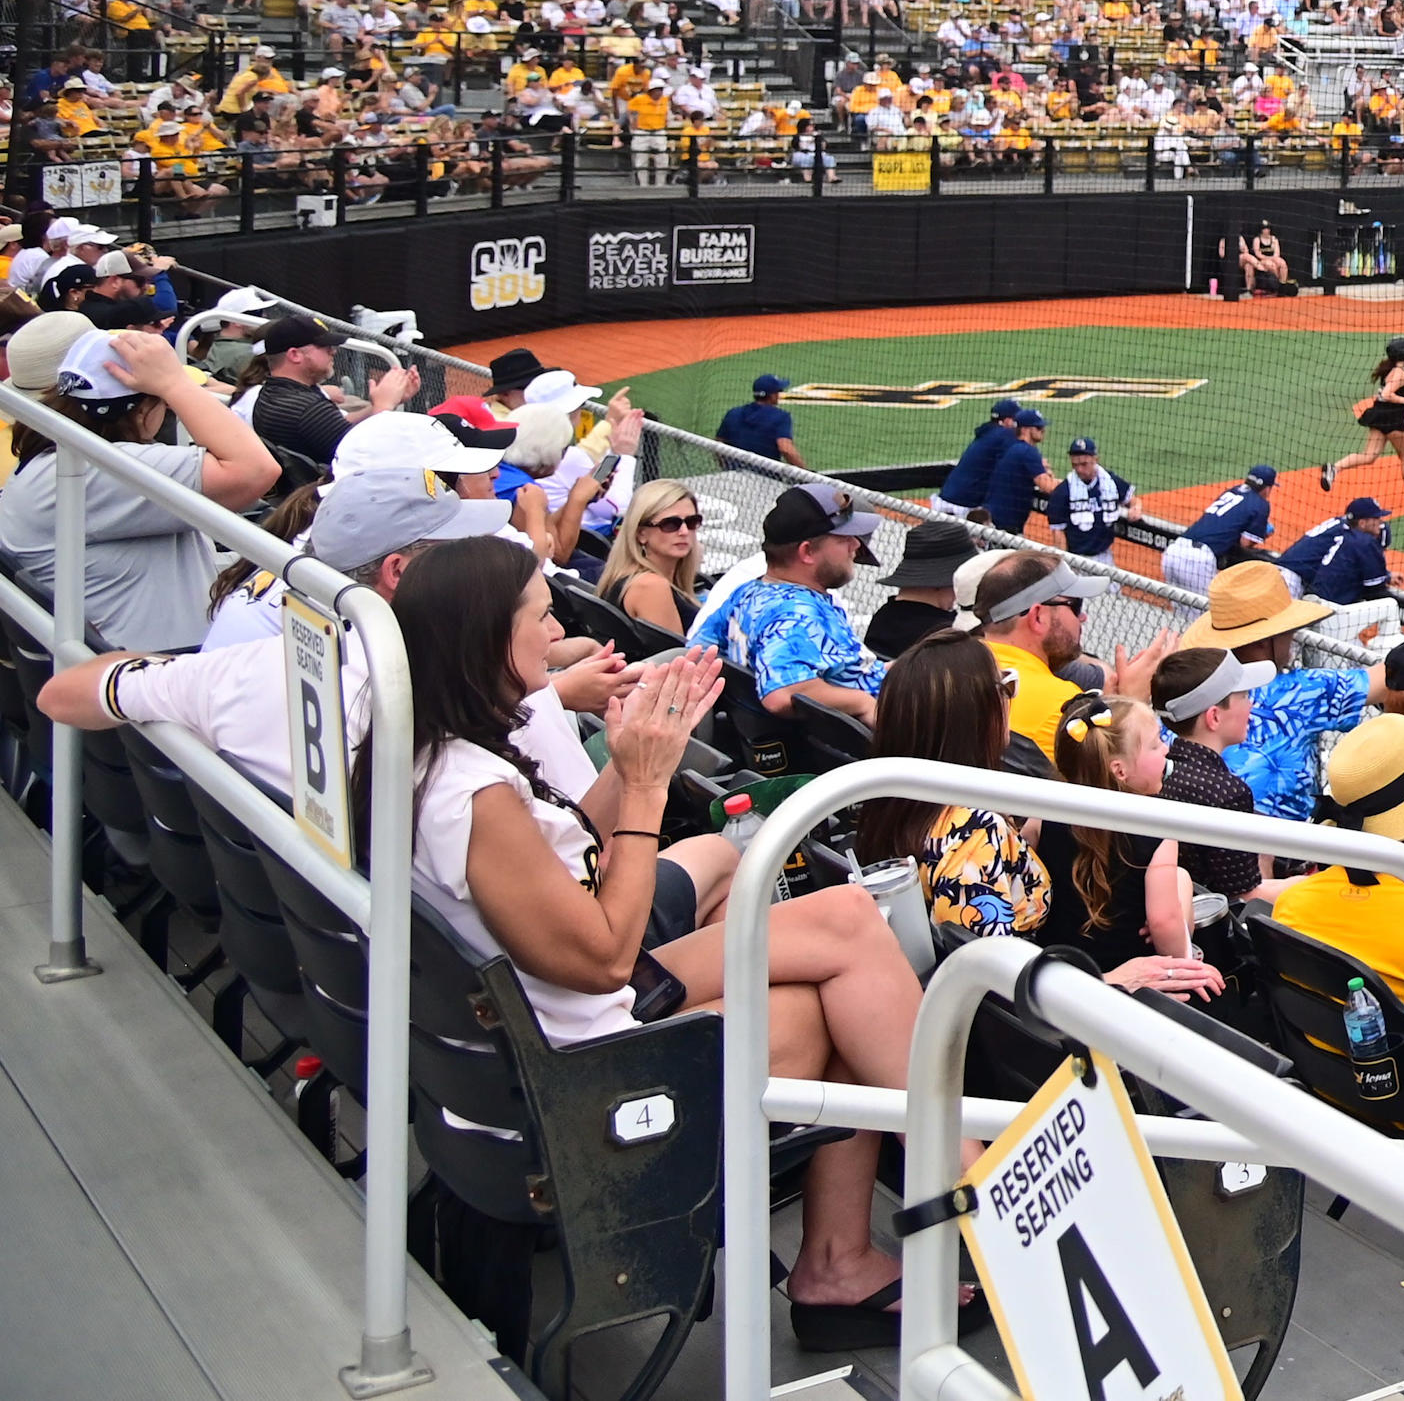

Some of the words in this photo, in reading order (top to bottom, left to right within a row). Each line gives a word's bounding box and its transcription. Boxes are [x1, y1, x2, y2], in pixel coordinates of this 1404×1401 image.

[589, 243, 668, 261] PEARL
[699, 232, 747, 247] FARM
[589, 259, 668, 276] RIVER
[680, 247, 748, 263] BUREAU
[589, 274, 668, 290] RESORT
[291, 615, 325, 658] RESERVED
[296, 645, 323, 683] SEATING
[300, 677, 327, 795] B
[635, 1103, 654, 1129] 4
[988, 1098, 1087, 1221] RESERVED
[1237, 1162, 1250, 1184] 3
[1014, 1147, 1095, 1249] SEATING
[1056, 1222, 1162, 1401] A
